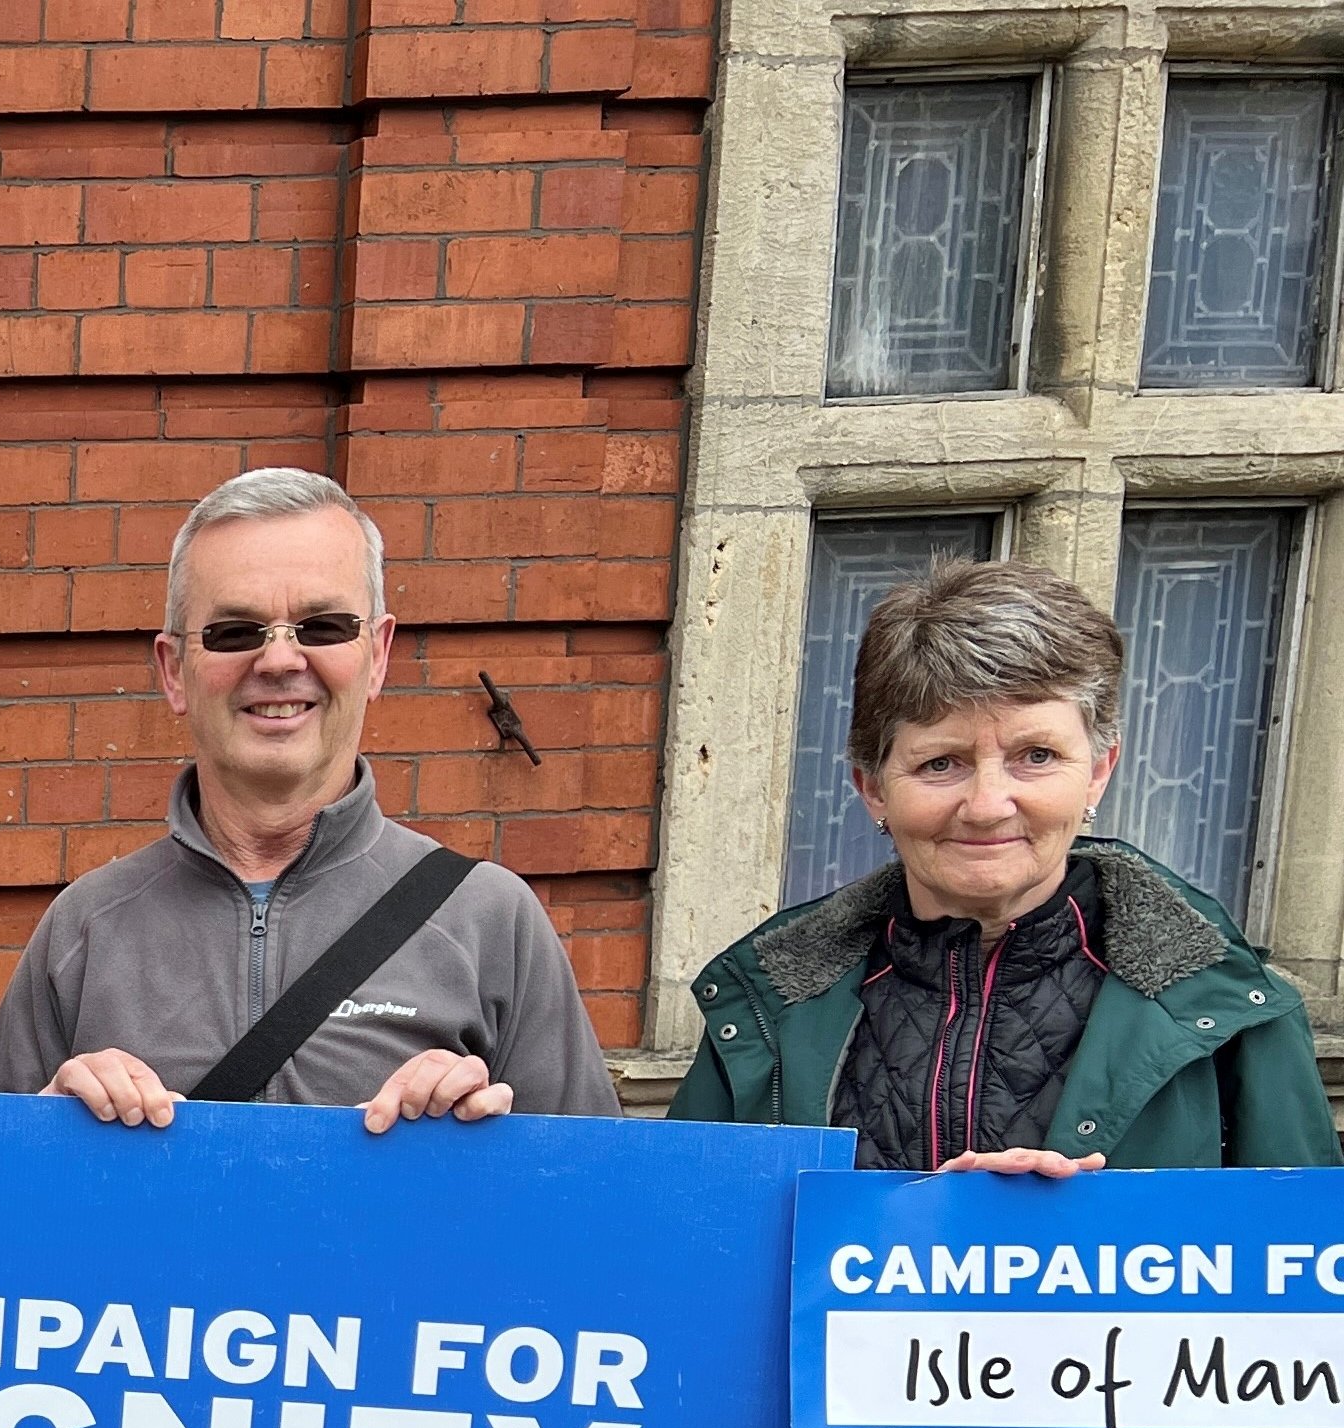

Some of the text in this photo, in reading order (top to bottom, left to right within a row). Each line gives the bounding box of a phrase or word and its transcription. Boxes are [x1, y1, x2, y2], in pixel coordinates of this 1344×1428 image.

[829, 1243, 1233, 1296] CAMPAIGN
[411, 1320, 649, 1410] FOR
[905, 1330, 1016, 1407] Isle
[1162, 1335, 1341, 1408] Man
